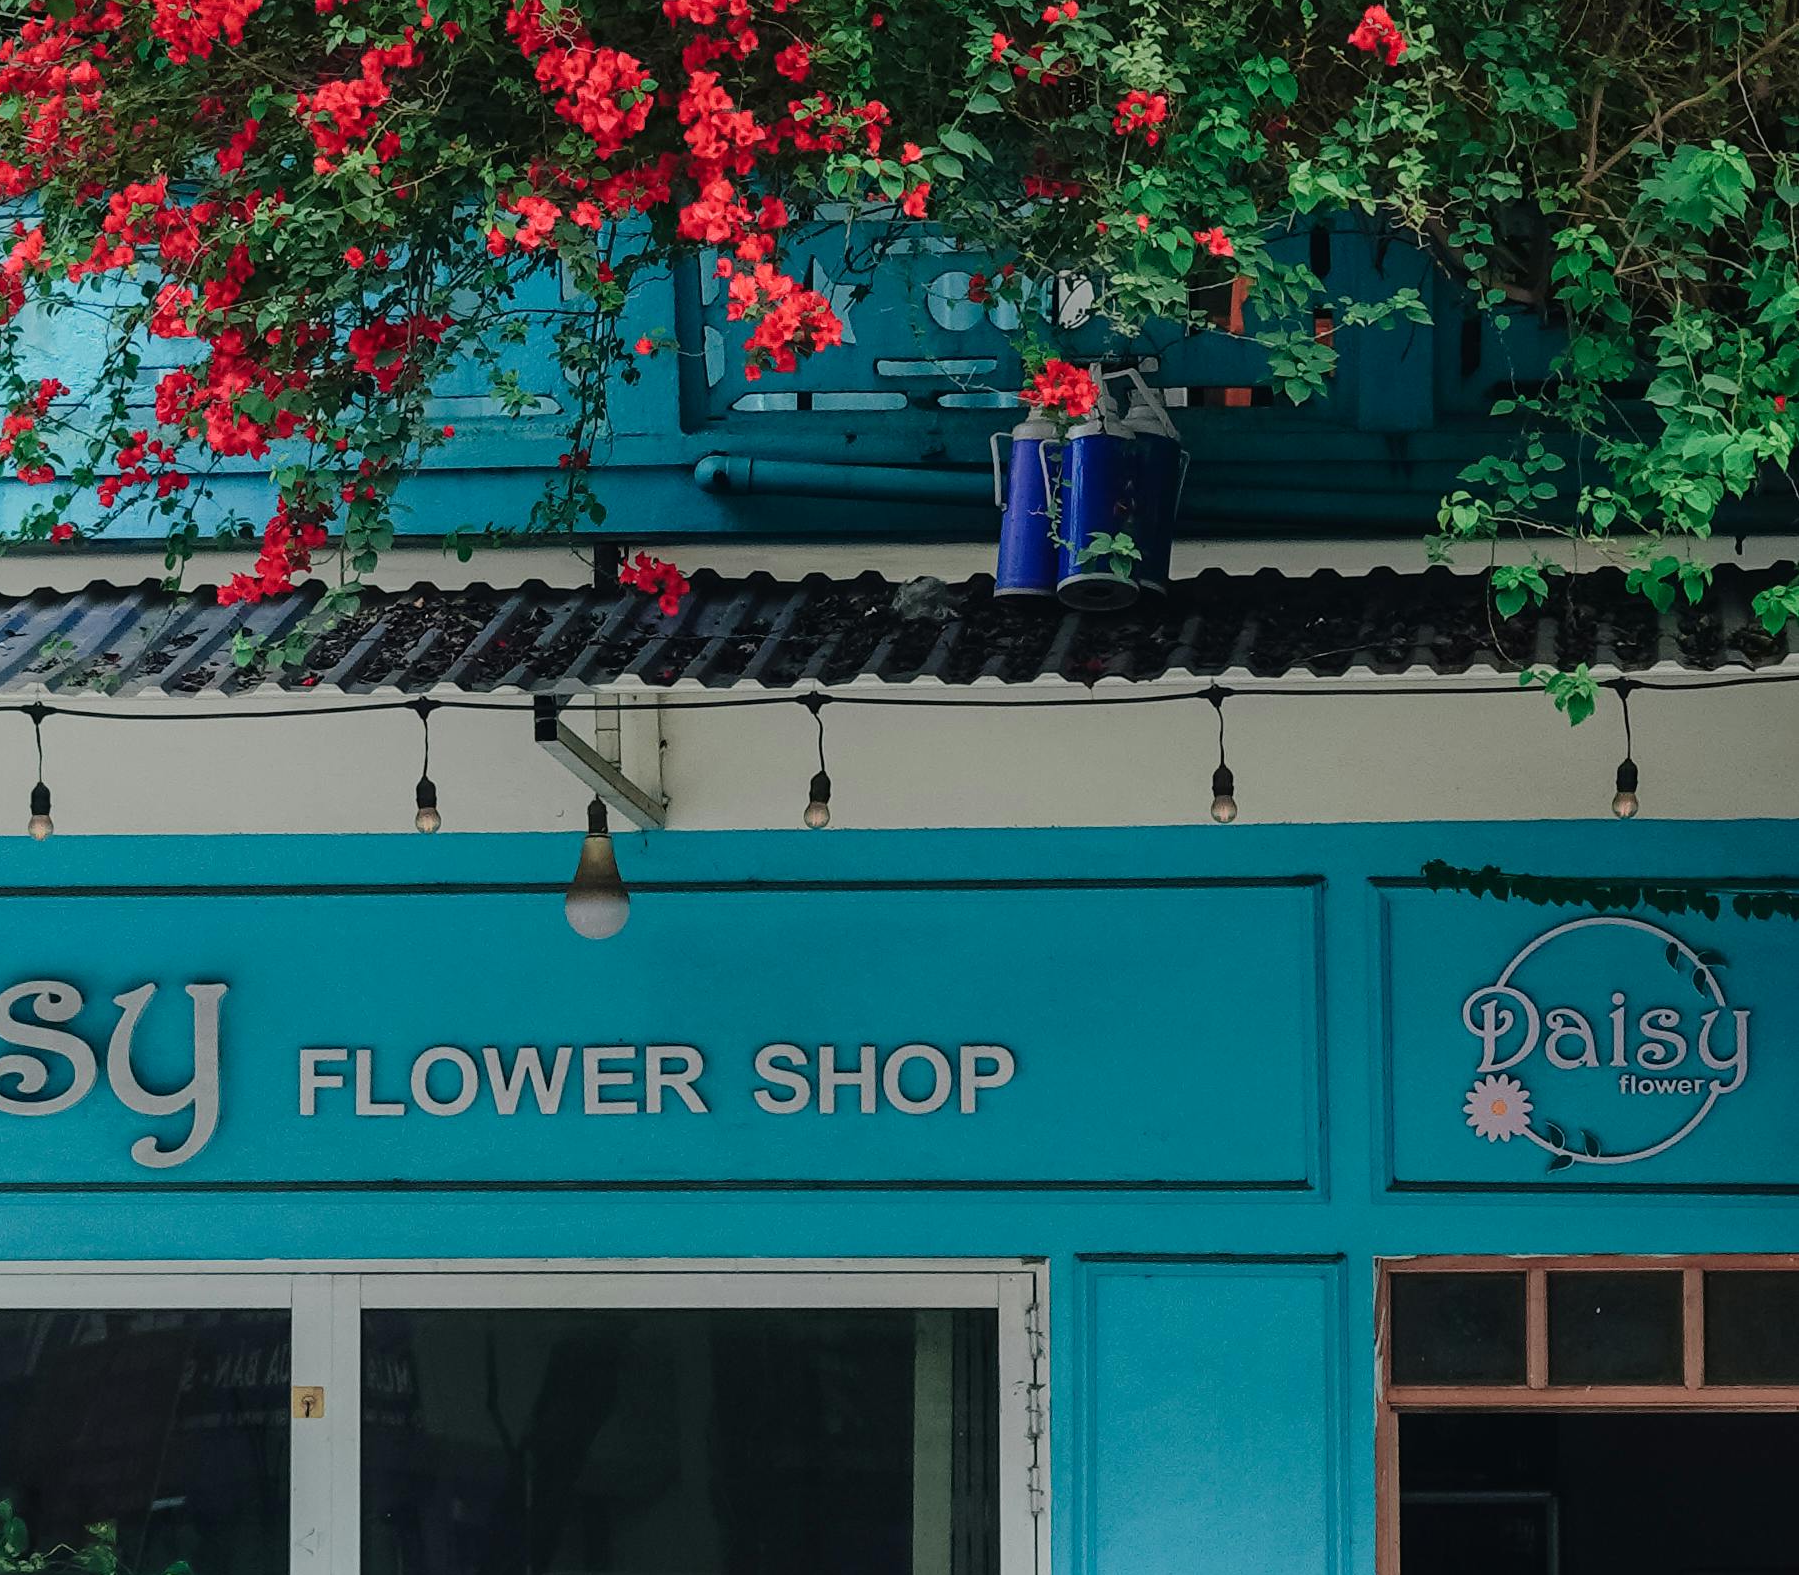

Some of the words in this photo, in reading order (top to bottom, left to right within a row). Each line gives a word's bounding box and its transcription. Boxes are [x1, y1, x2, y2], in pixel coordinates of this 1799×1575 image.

[297, 1042, 709, 1117] FLOWER
[753, 1040, 1018, 1117] SHOP
[1462, 985, 1751, 1095] Daisy
[1618, 1074, 1706, 1097] flower
